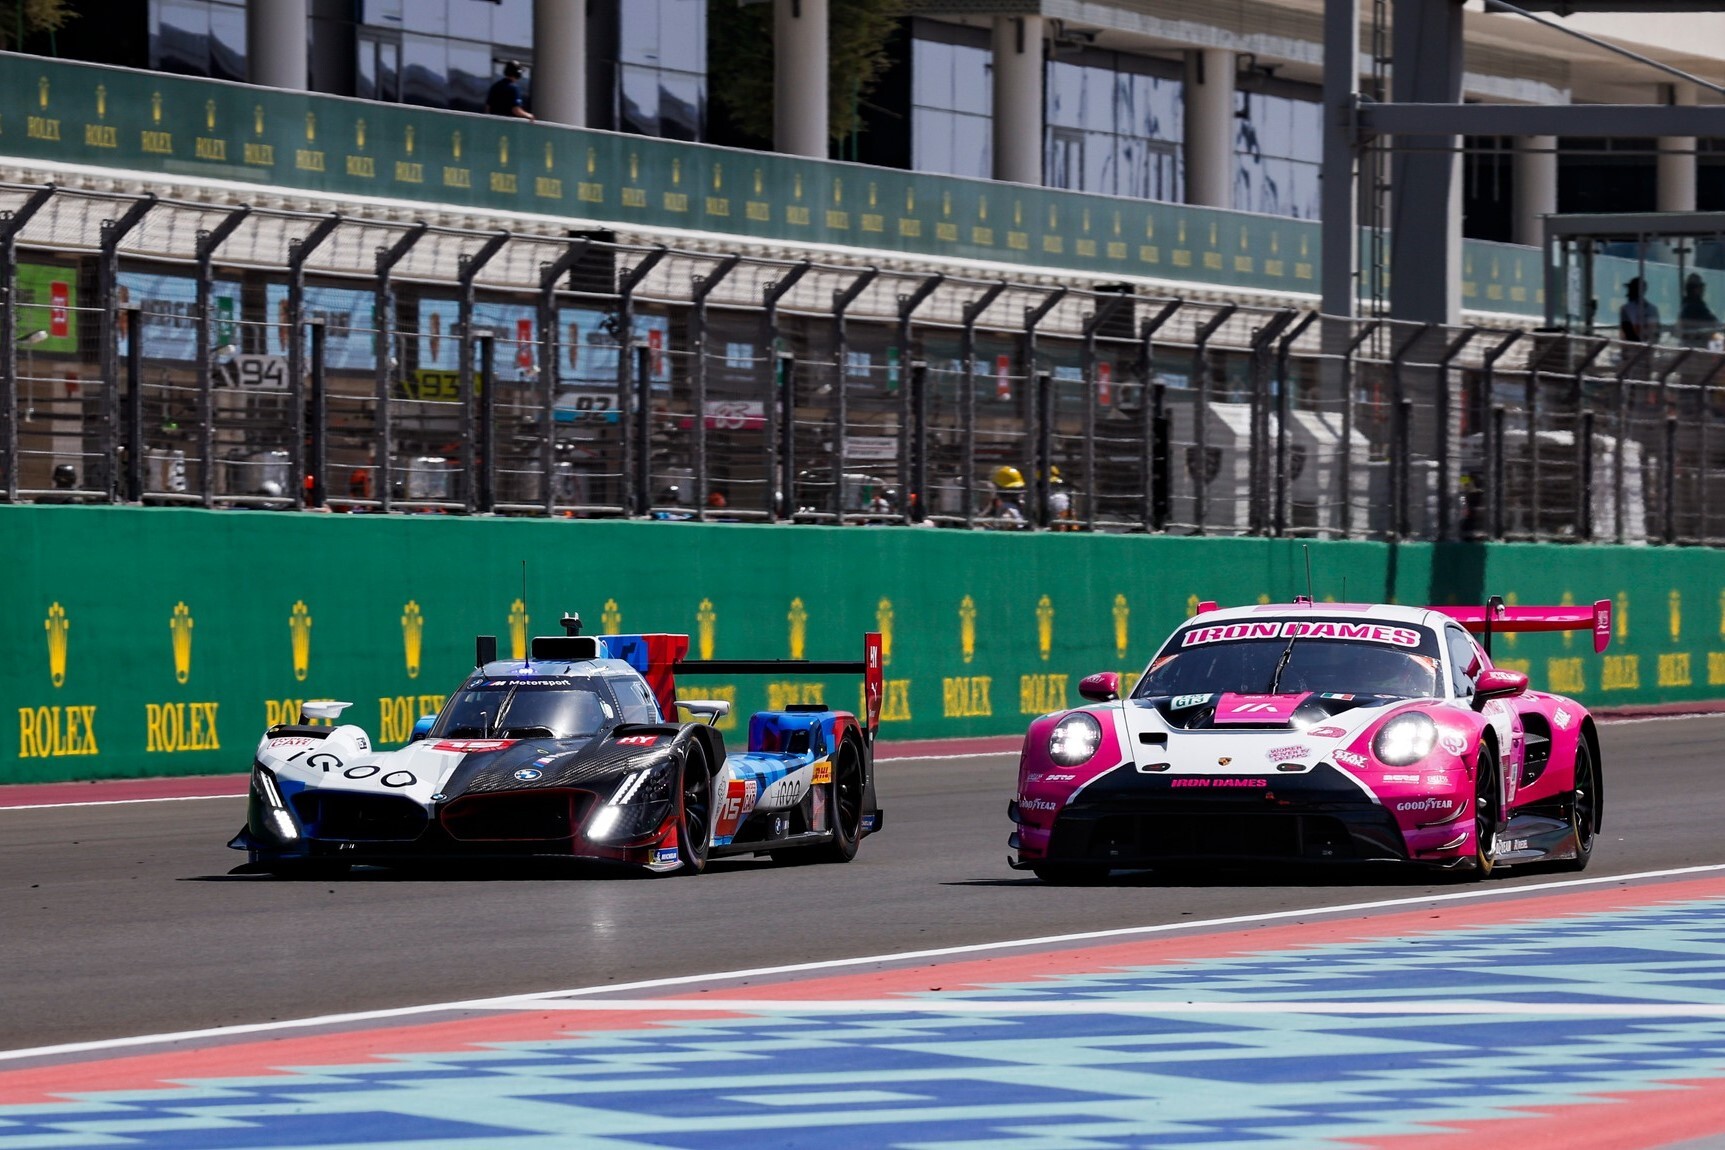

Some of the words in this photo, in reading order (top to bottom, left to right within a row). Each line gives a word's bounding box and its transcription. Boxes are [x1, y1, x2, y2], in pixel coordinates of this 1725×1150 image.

[28, 117, 60, 140] ROLEX
[242, 360, 283, 386] 94
[422, 374, 459, 397] 93
[1182, 622, 1281, 647] IRON
[1281, 621, 1421, 647] DAMES
[509, 679, 572, 687] Motorsport
[1020, 673, 1069, 715] ROLEX
[942, 676, 992, 718] ROLEX
[19, 705, 98, 758] ROLEX
[146, 702, 220, 753] ROLEX
[271, 740, 310, 748] CAR
[620, 736, 658, 744] HY
[1171, 779, 1210, 788] IRON
[1212, 779, 1268, 788] DAMES
[722, 798, 742, 821] 15
[1397, 797, 1452, 811] GOODYEAR
